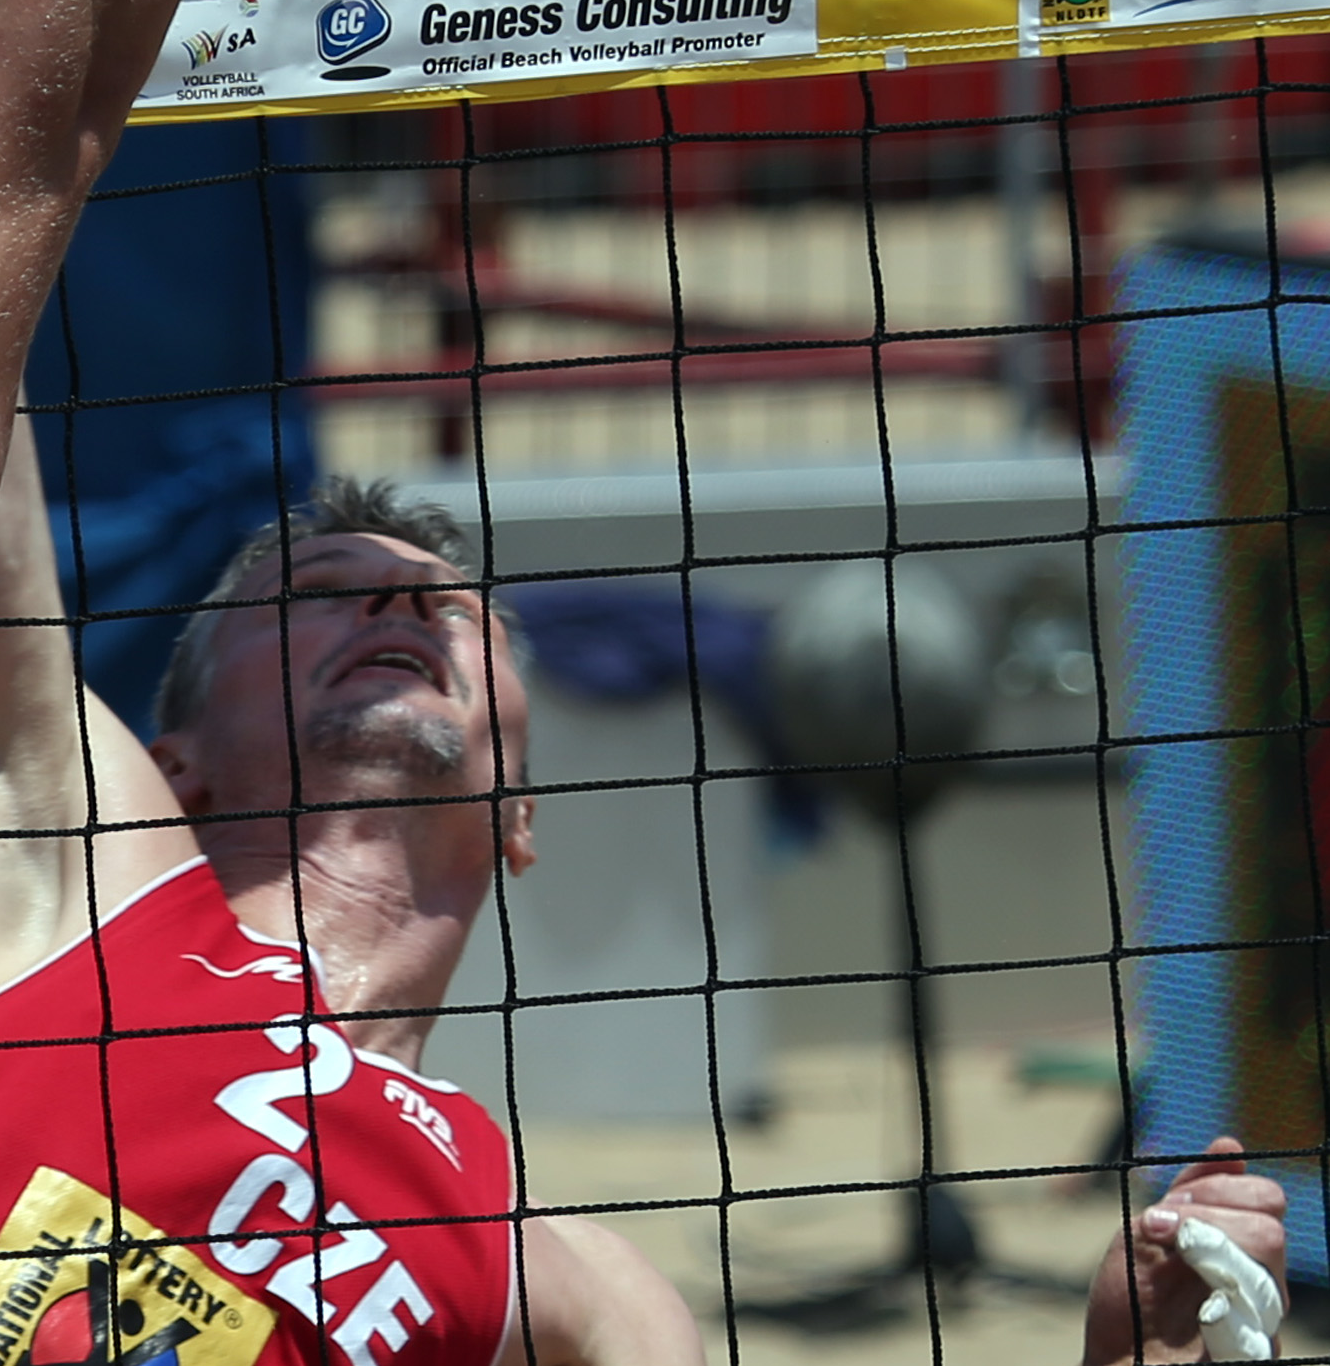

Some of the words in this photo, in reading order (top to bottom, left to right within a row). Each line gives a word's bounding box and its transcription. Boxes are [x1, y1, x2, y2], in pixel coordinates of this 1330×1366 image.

[330, 7, 366, 36] GC
[420, 0, 564, 46] Geness
[1056, 6, 1107, 22] NLDTF
[422, 53, 495, 76] Official
[501, 46, 563, 67] Beach
[569, 39, 666, 63] Volleyball
[671, 31, 765, 53] Promoter
[176, 87, 218, 100] SOUTH
[221, 85, 265, 98] AFRICA
[182, 72, 258, 87] VOLLEYBALL
[213, 1013, 355, 1153] 2
